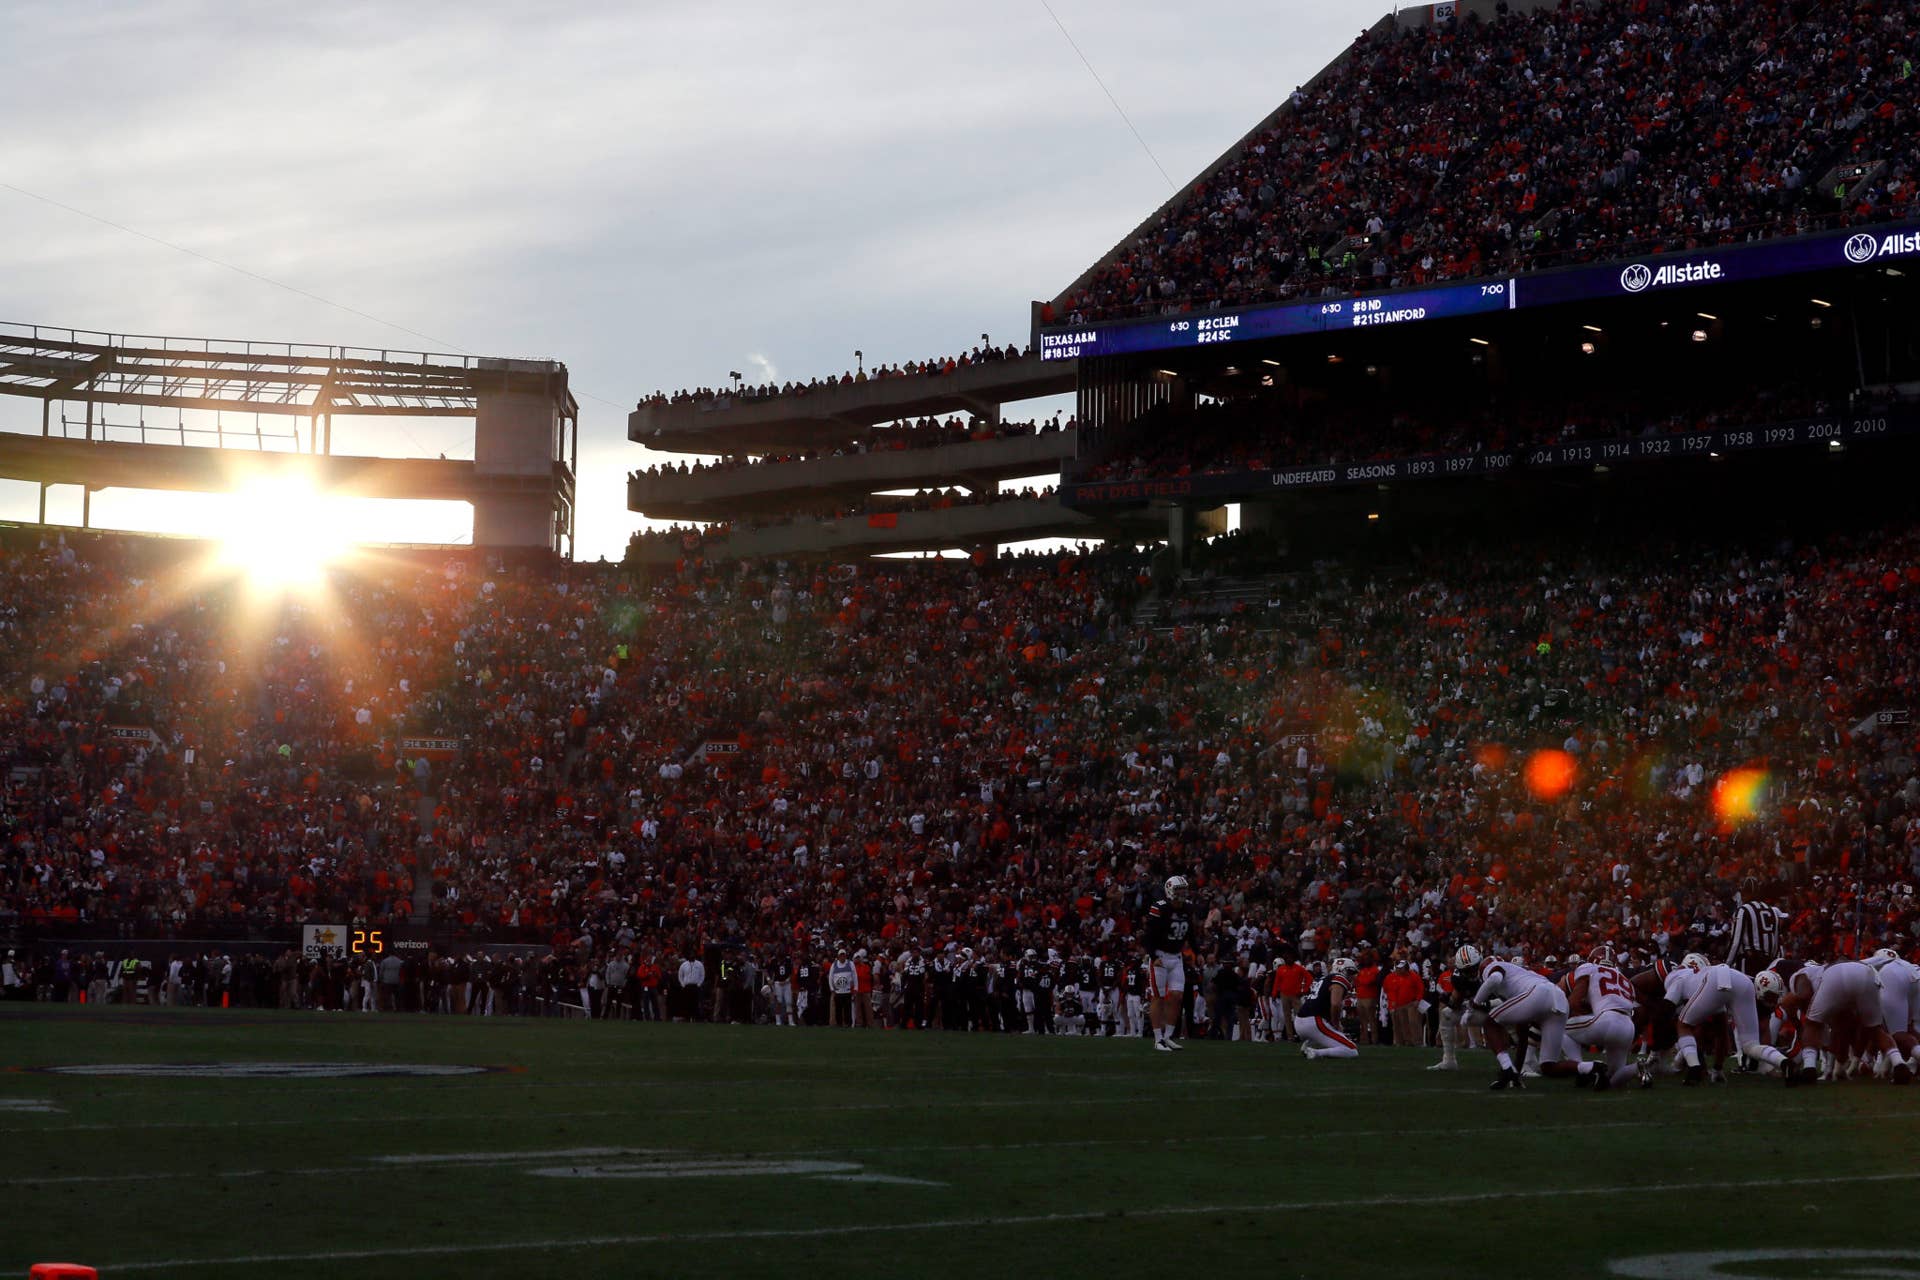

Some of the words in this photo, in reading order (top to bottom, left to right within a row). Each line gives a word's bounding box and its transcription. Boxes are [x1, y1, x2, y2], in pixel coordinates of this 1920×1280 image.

[1436, 6, 1452, 17] 62
[1651, 260, 1721, 286] Allstate
[1481, 284, 1504, 296] 7:00
[1321, 303, 1342, 314] 6:30
[1353, 301, 1367, 312] #8
[1368, 299, 1382, 311] ND
[1198, 319, 1212, 330] #2
[1212, 316, 1239, 329] CLEM
[1353, 314, 1373, 326] #21
[1373, 307, 1426, 324] STANFORD
[1170, 321, 1190, 332] 6:30
[1044, 333, 1073, 347] TEXAS
[1074, 331, 1097, 343] A&M
[1198, 331, 1218, 343] #24
[1218, 330, 1231, 340] SC
[1044, 348, 1062, 359] #18
[1063, 346, 1080, 357] LSU
[1272, 469, 1336, 486] UNDEFEATED
[1346, 463, 1396, 480] SEASONS
[1408, 461, 1435, 475] 1893
[1444, 457, 1474, 472] 1897
[1562, 446, 1592, 461] 1913
[1602, 443, 1630, 457] 1914
[1640, 439, 1671, 454] 1932
[1682, 436, 1712, 450] 1957
[1723, 432, 1753, 447] 1958
[1764, 427, 1795, 443] 1993
[1807, 423, 1841, 438] 2004
[1854, 418, 1887, 433] 2010
[1076, 486, 1104, 500] PAT
[1109, 484, 1139, 499] DYE
[1144, 481, 1191, 496] FIELD
[1760, 910, 1774, 931] C
[352, 930, 384, 953] 25
[393, 939, 429, 949] verizon
[1598, 966, 1633, 1000] 29
